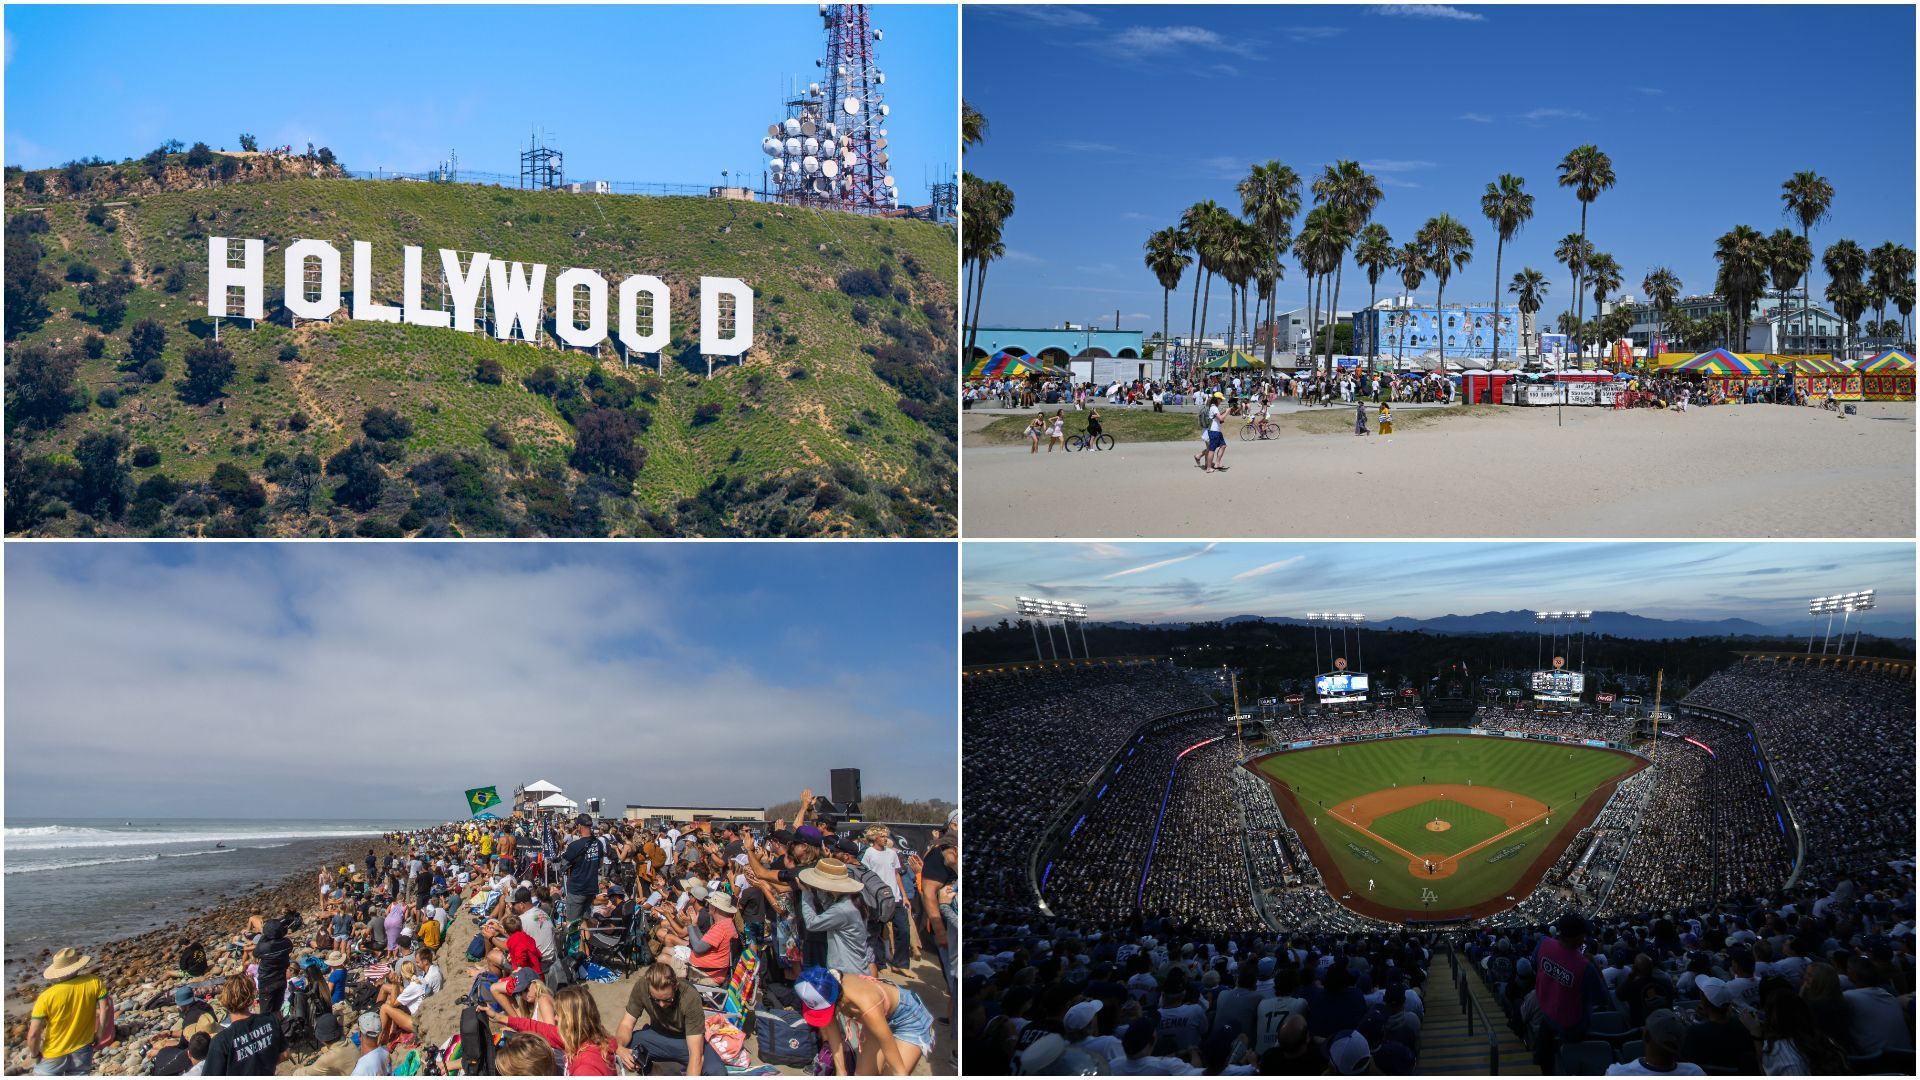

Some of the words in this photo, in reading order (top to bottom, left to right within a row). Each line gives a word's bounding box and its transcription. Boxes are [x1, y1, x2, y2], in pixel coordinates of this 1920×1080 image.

[208, 237, 754, 356] HOLLYWOOD
[1420, 887, 1438, 902] LA
[1266, 1011, 1289, 1032] 17
[233, 1033, 249, 1048] I'M
[249, 1023, 273, 1040] YOUR
[236, 1033, 273, 1062] ENEMY
